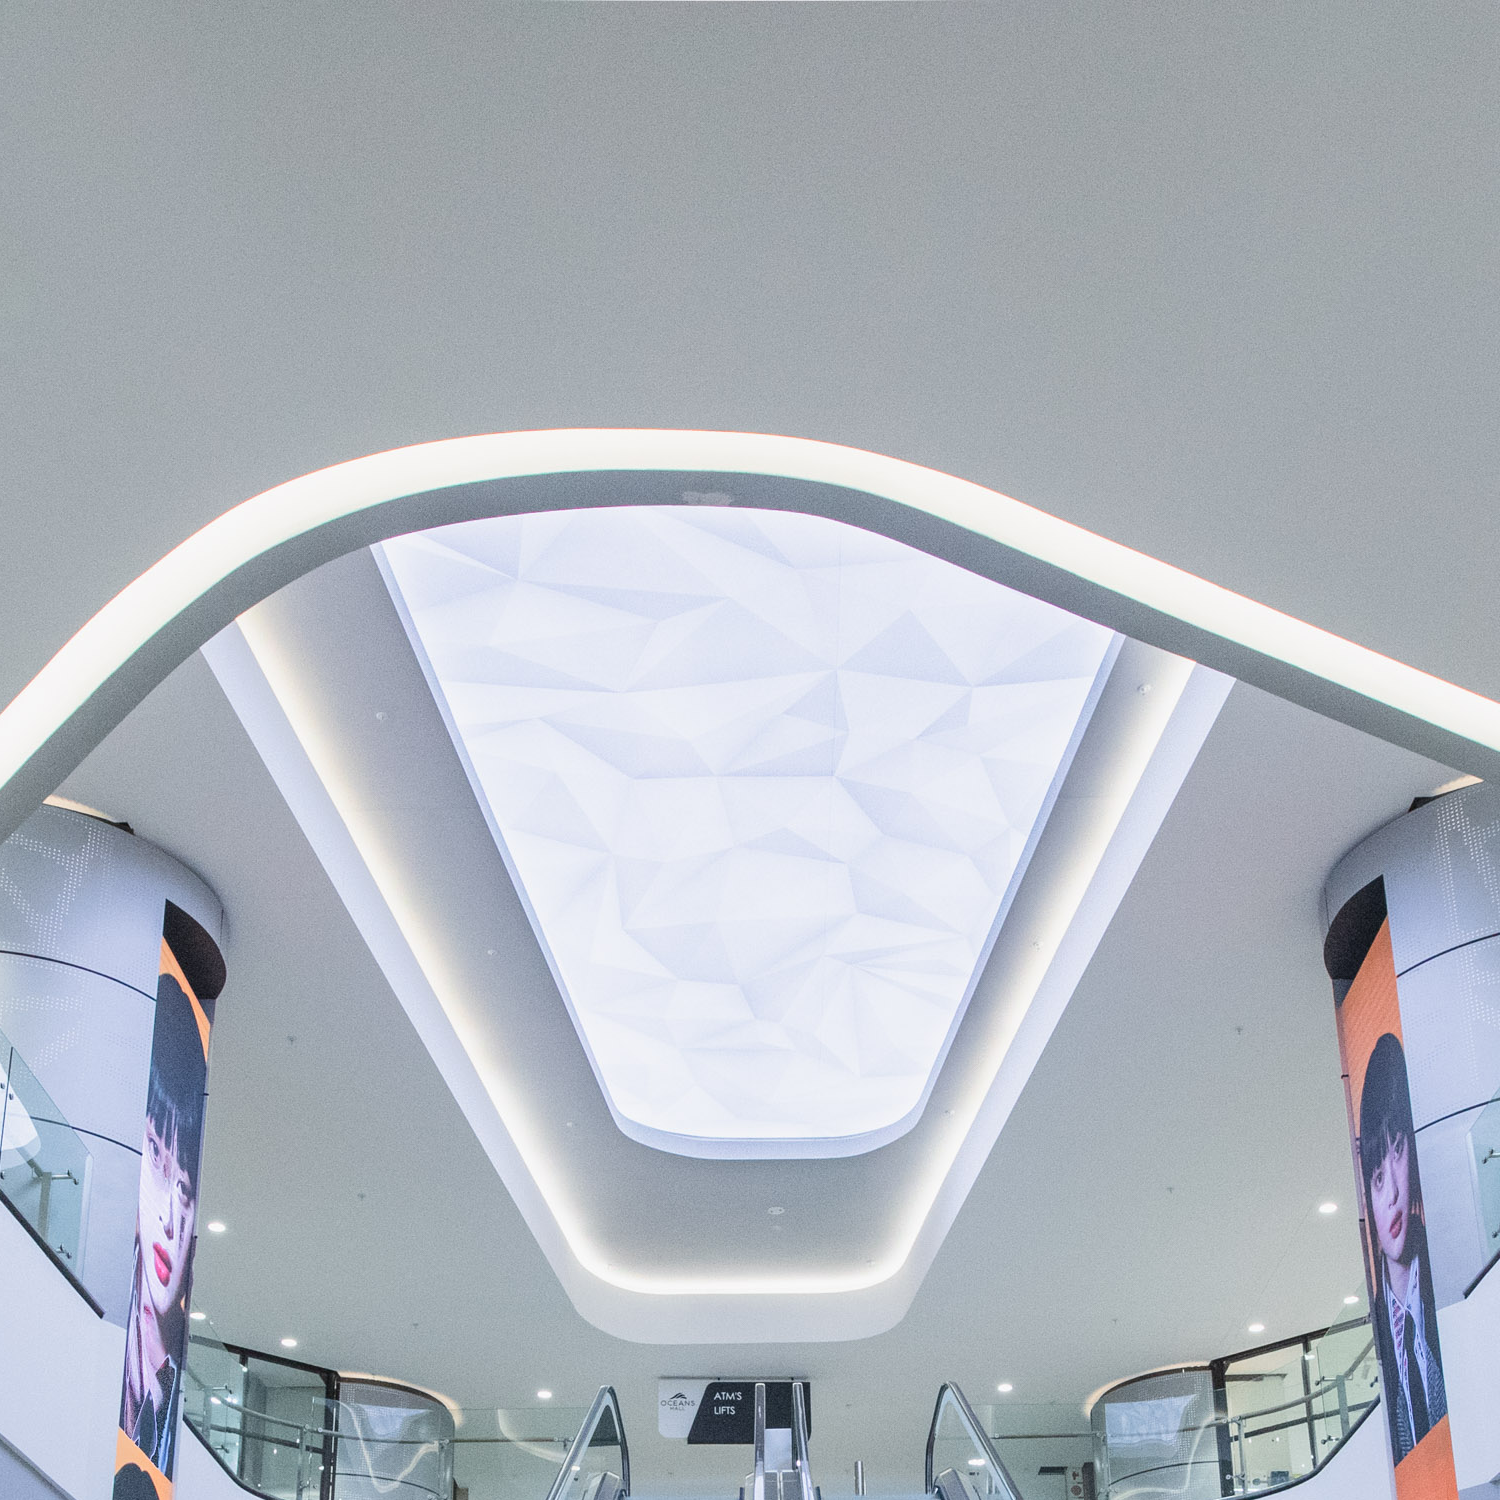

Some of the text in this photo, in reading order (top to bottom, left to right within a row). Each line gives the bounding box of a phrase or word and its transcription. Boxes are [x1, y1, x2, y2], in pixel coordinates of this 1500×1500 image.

[713, 1391, 743, 1401] ATM'S
[660, 1399, 696, 1407] OCEANS
[713, 1406, 736, 1415] LIFTS
